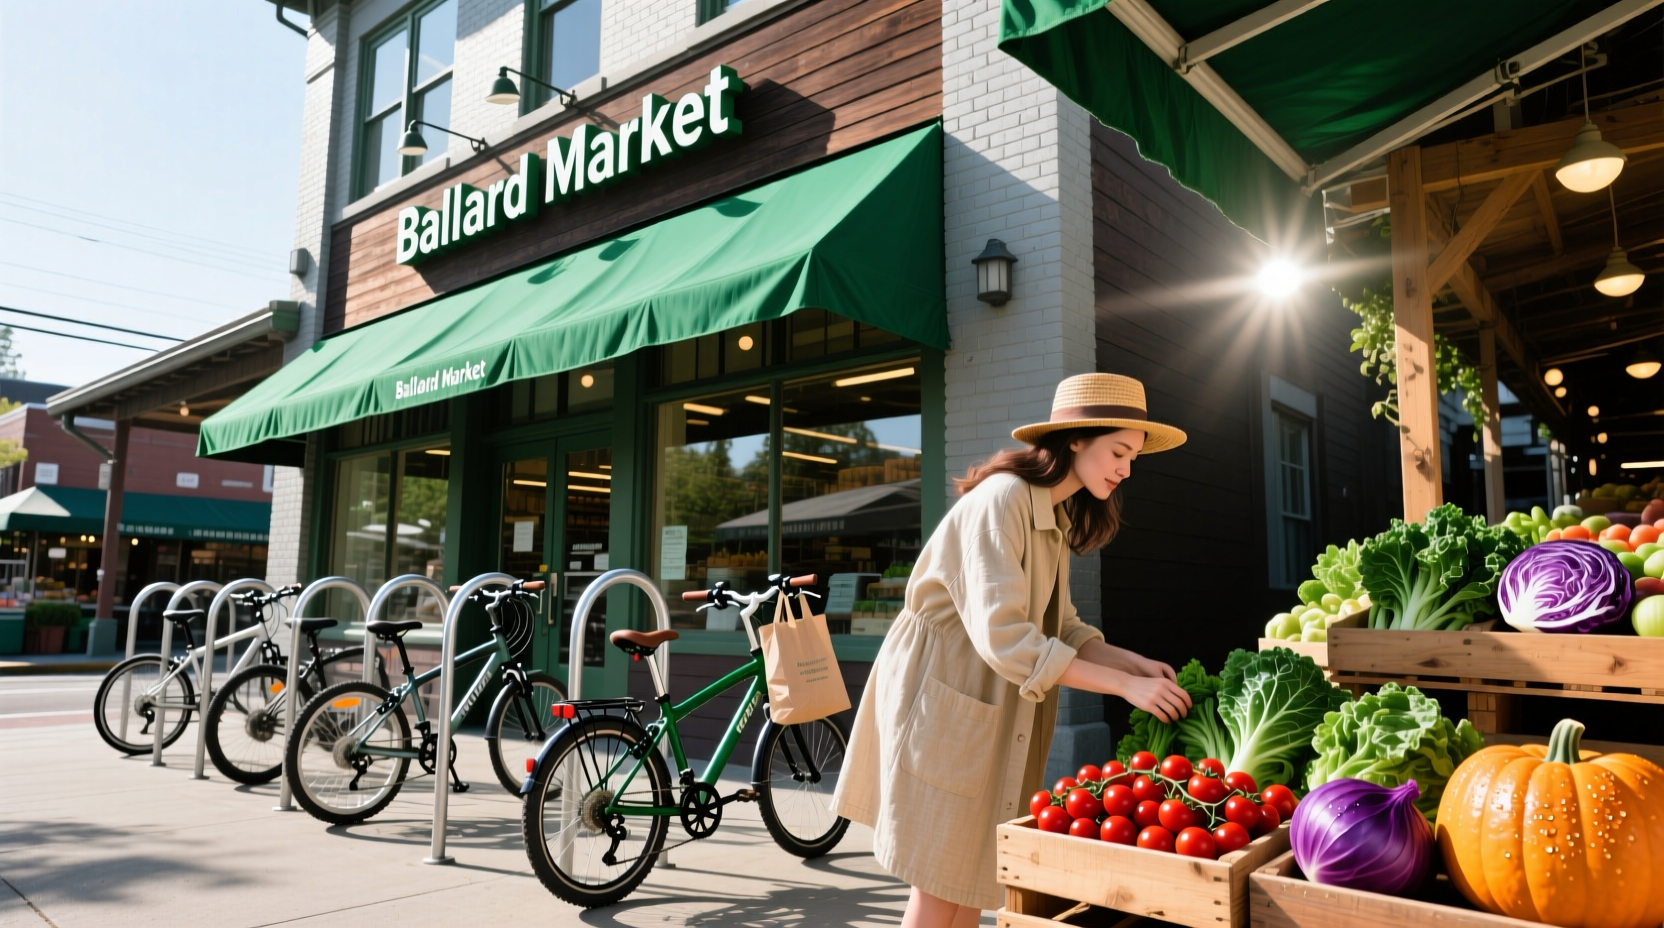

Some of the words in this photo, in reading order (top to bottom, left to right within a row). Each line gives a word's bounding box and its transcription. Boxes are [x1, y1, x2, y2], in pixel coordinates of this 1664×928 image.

[396, 152, 531, 265] Ballard
[545, 64, 731, 203] Market
[395, 369, 440, 400] Ballard
[441, 359, 486, 389] Market
